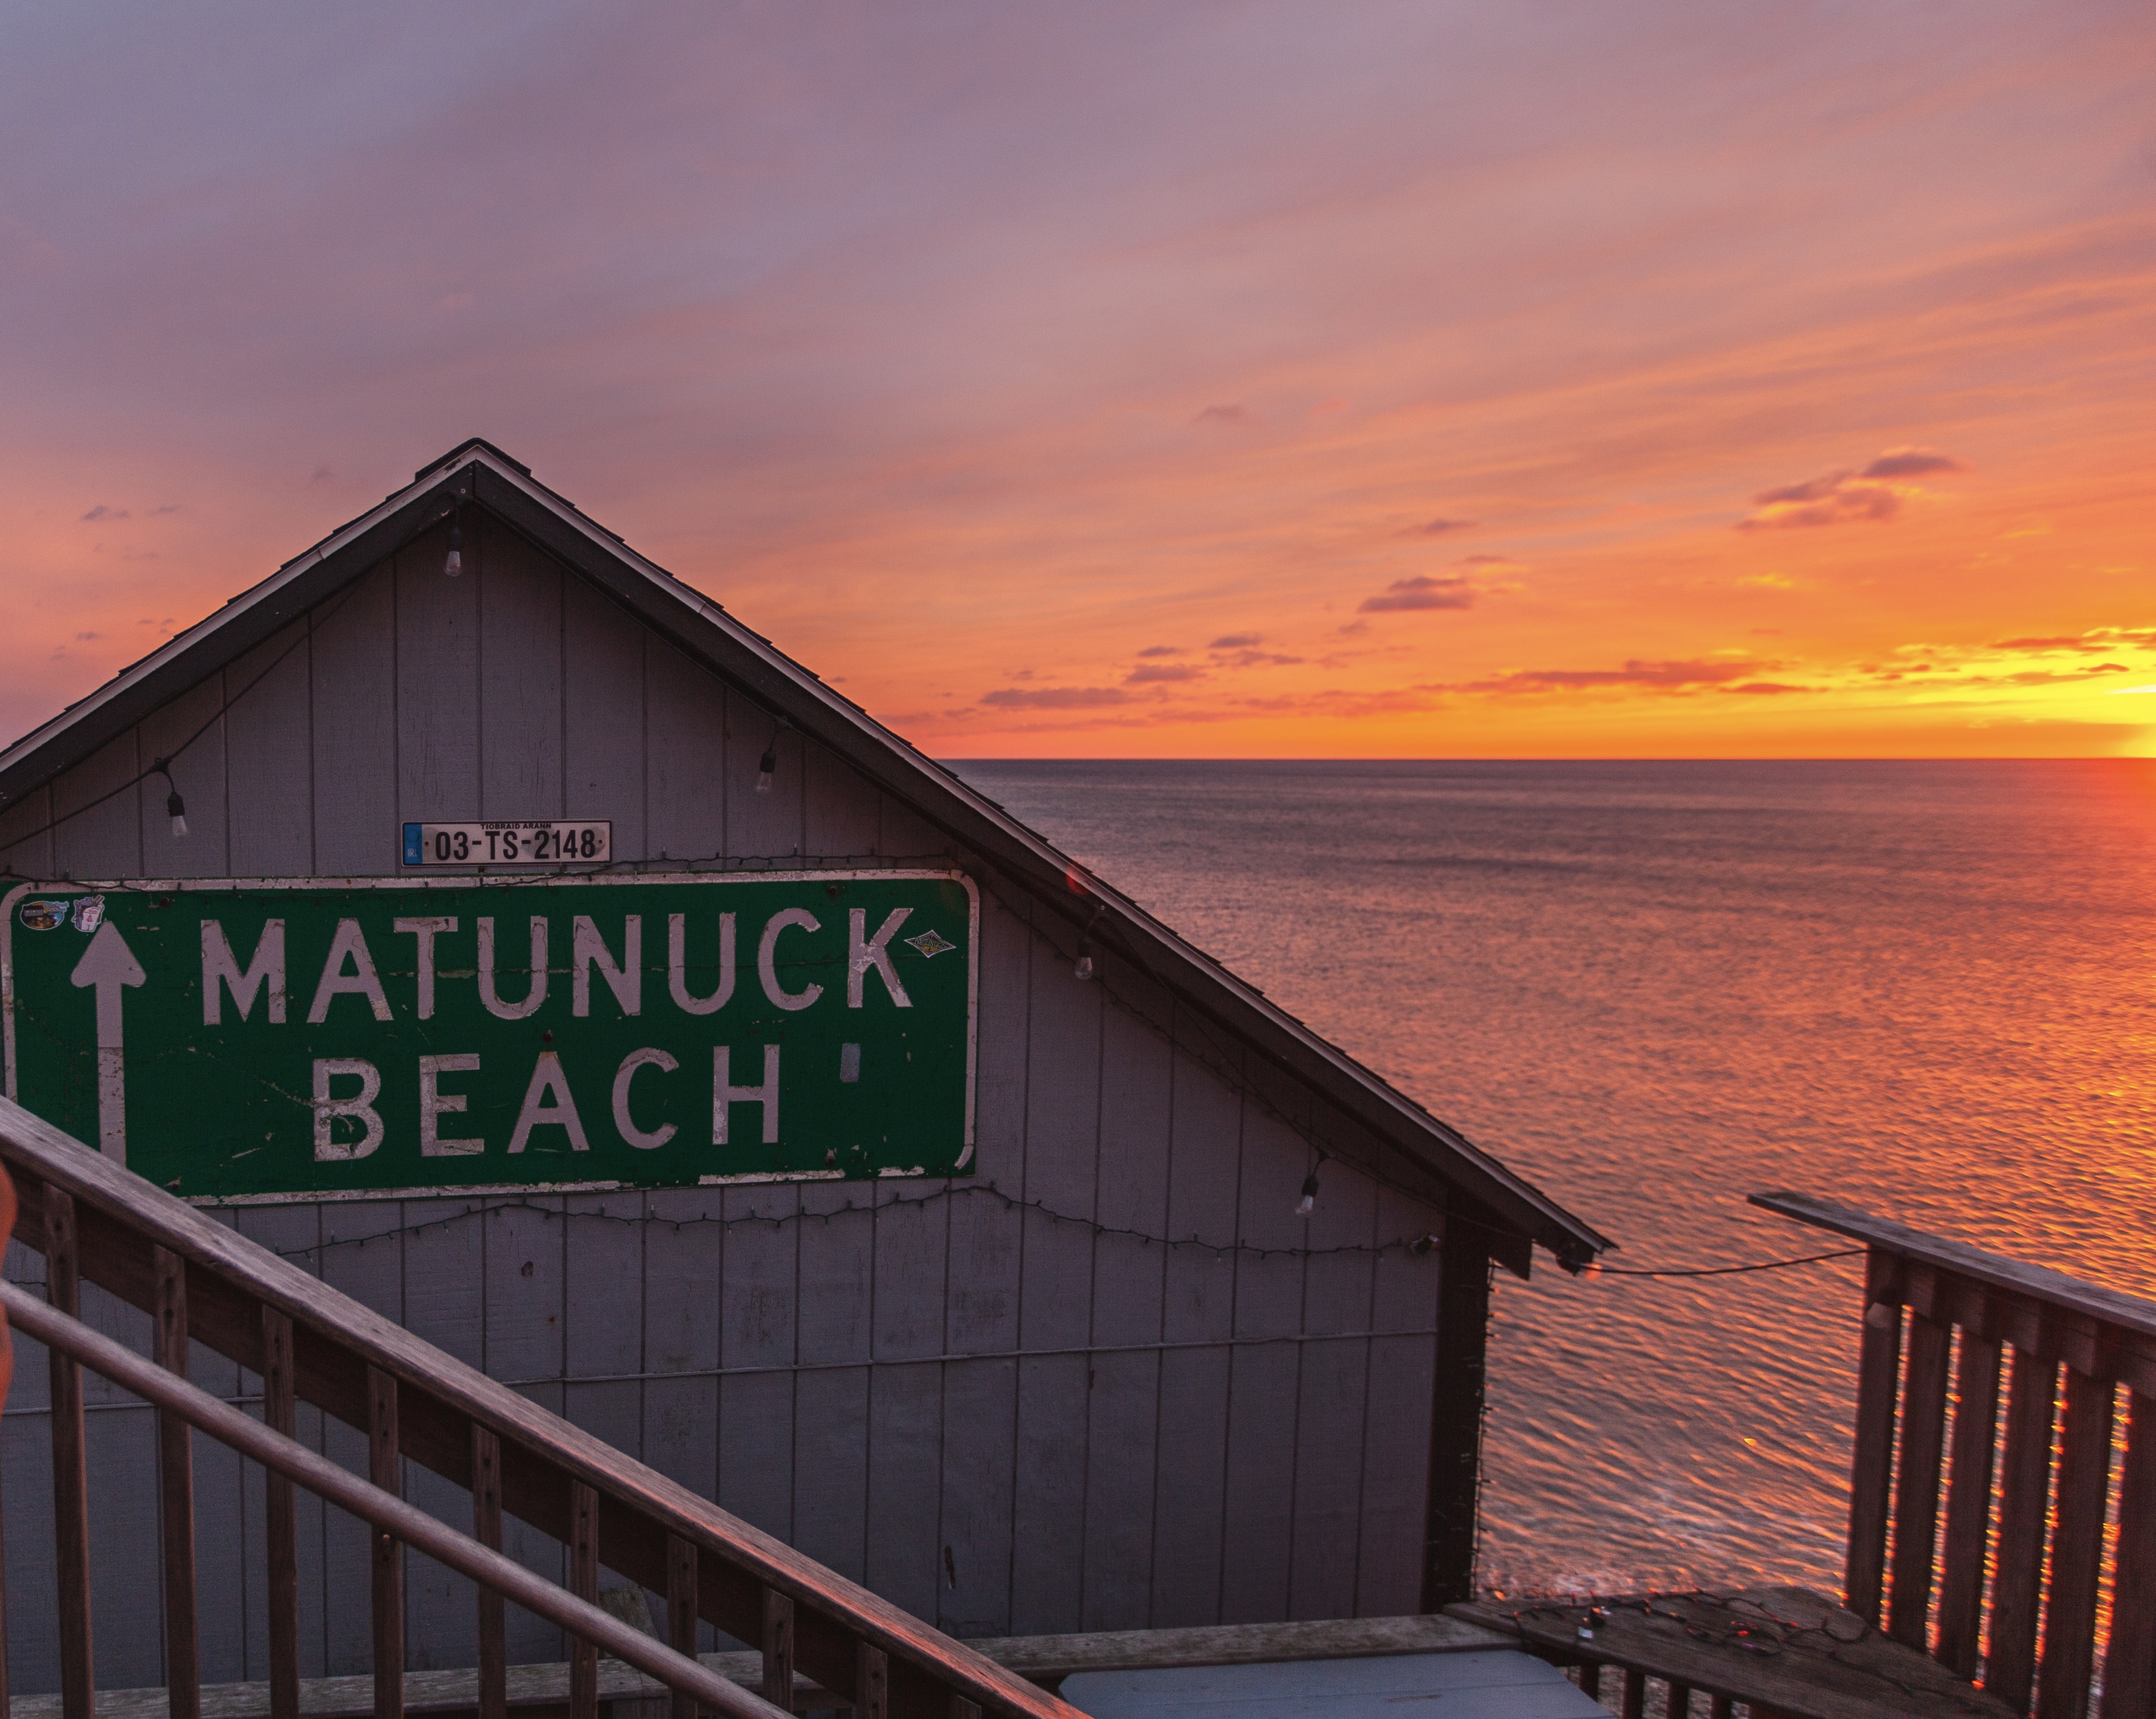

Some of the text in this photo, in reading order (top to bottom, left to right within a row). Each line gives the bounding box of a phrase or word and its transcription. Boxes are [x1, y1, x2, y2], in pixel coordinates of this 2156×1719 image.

[407, 848, 418, 858] IRL
[435, 829, 596, 861] 03-TS-2148
[200, 908, 913, 1025] MATUNUCK
[313, 1044, 780, 1162] BEACH
